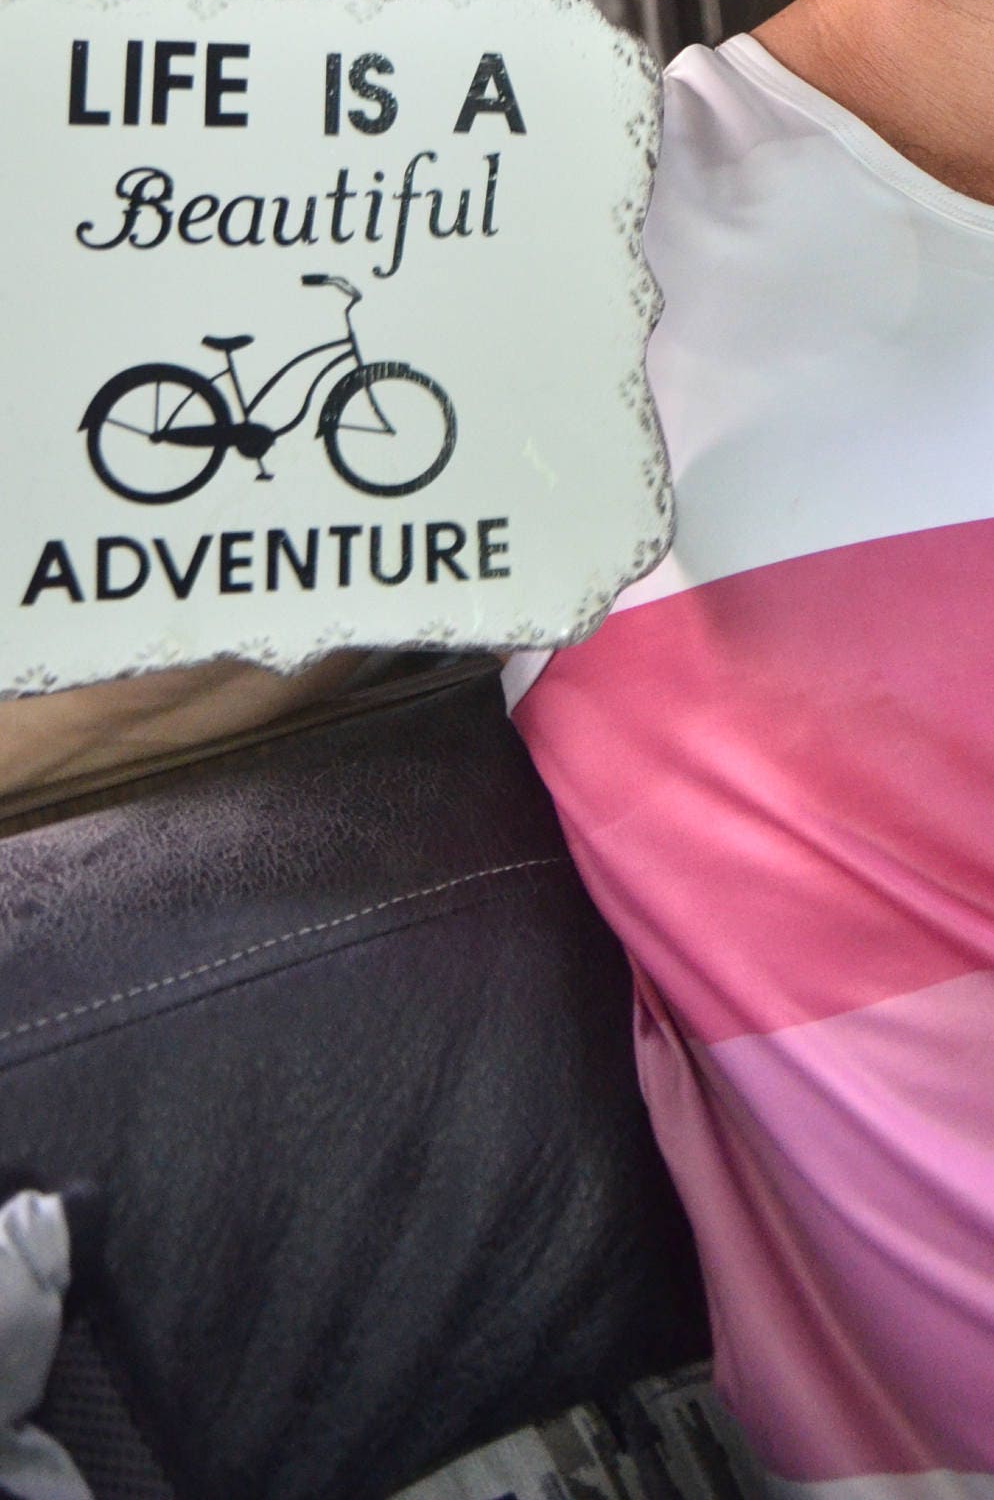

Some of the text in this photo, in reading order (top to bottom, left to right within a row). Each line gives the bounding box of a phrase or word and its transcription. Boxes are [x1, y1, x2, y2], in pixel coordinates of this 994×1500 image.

[67, 39, 528, 136] LIFE IS A
[76, 151, 501, 278] Beautiful
[20, 517, 511, 607] ADVENTURE
